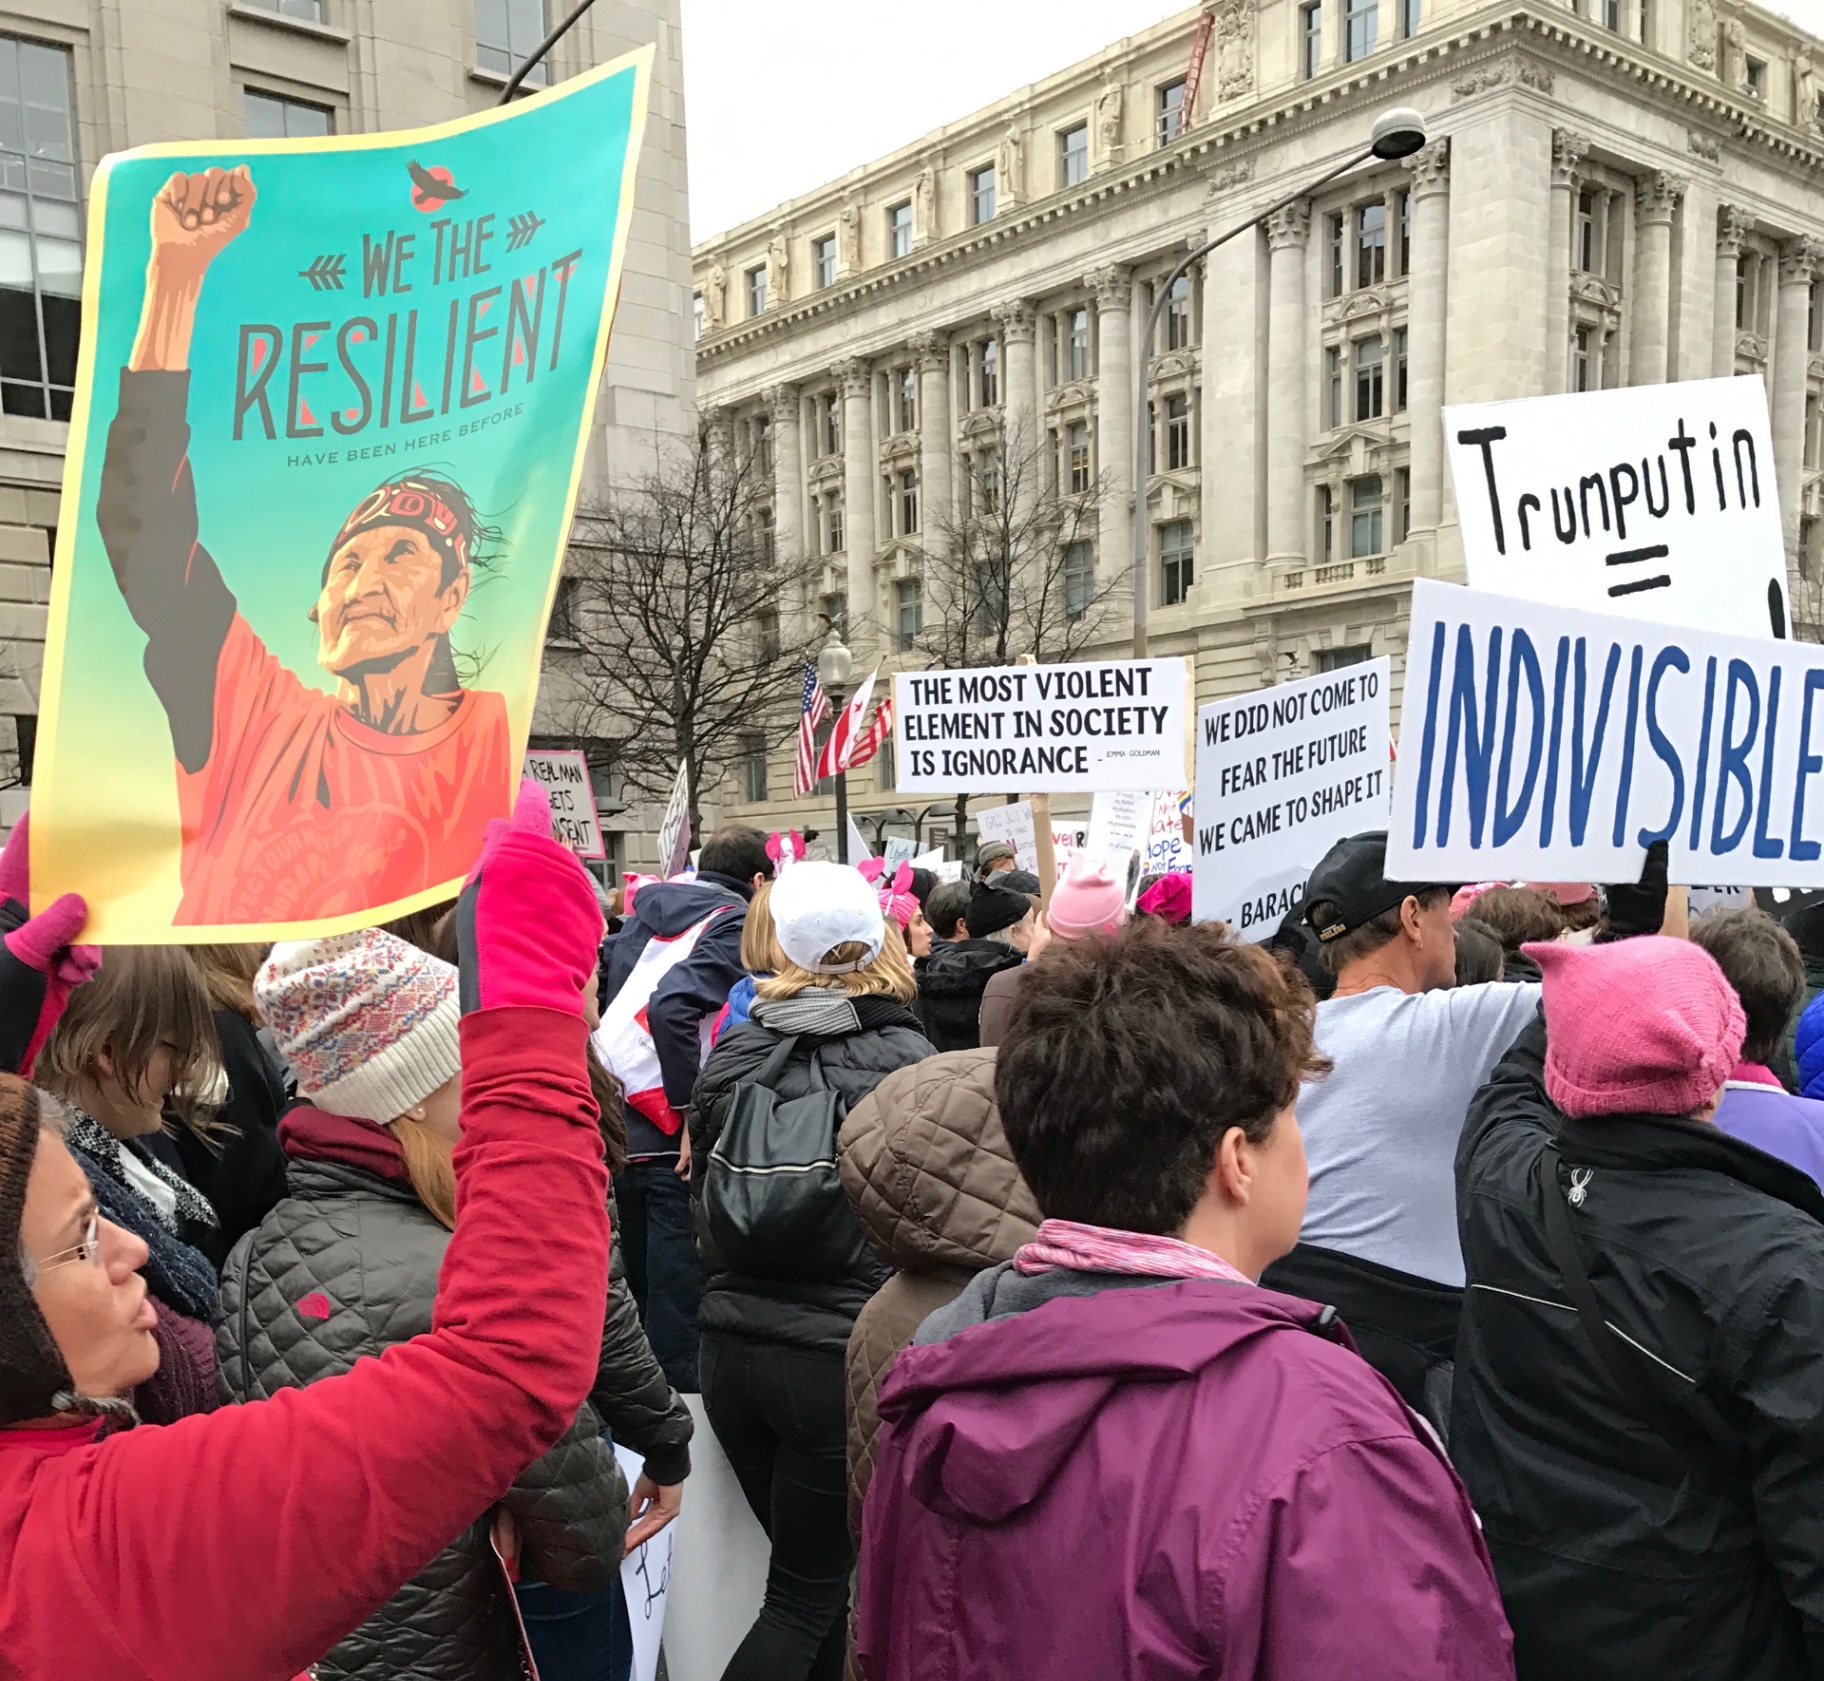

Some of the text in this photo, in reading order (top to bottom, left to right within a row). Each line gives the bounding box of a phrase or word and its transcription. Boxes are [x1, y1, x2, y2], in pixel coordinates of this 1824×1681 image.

[362, 213, 496, 299] WE THE
[232, 248, 583, 441] RESILIENT
[287, 403, 524, 468] HAVE BEEN HERE BEFORE
[1457, 418, 1762, 557] Trumputin
[910, 667, 1152, 706] THE MOST VIOLENT
[1205, 672, 1379, 747] WE DID NOT COME TO
[905, 706, 1169, 741] ELEMENT IN SOCIETY
[1413, 620, 1824, 862] INDIVISIBLE
[529, 759, 559, 784] REAL
[559, 763, 584, 784] MAN
[911, 751, 936, 776] IS
[942, 746, 1088, 776] IGNORANCE
[1106, 750, 1126, 758] EMMA
[1129, 749, 1160, 757] GOLDMAN
[1221, 725, 1368, 797] FEAR THE FUTURE
[551, 817, 590, 846] NSENT
[1199, 770, 1383, 856] WE CAME TO SHAPE IT
[1241, 880, 1307, 929] BARAC
